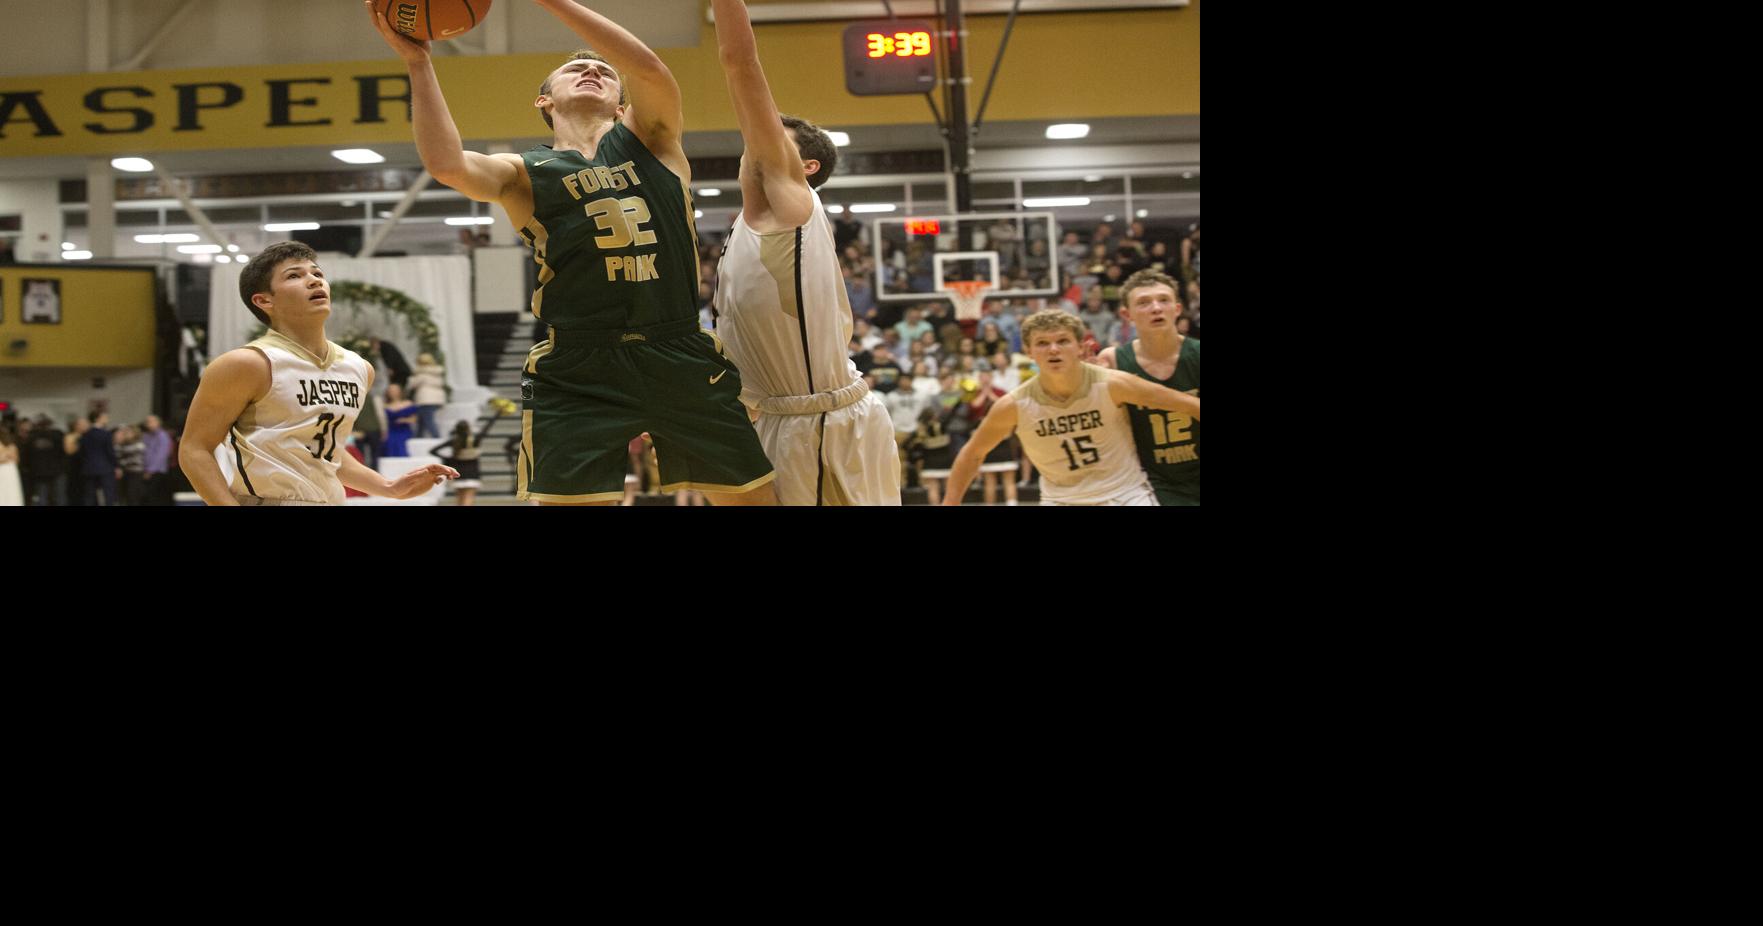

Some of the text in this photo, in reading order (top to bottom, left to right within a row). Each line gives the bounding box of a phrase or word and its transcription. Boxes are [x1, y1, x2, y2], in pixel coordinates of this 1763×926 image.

[867, 32, 931, 57] 3:39
[584, 195, 658, 250] 32
[296, 379, 359, 409] JASPER
[306, 412, 345, 462] 31
[1035, 409, 1104, 438] JASPER
[1149, 411, 1193, 446] 12
[1061, 434, 1101, 472] 15
